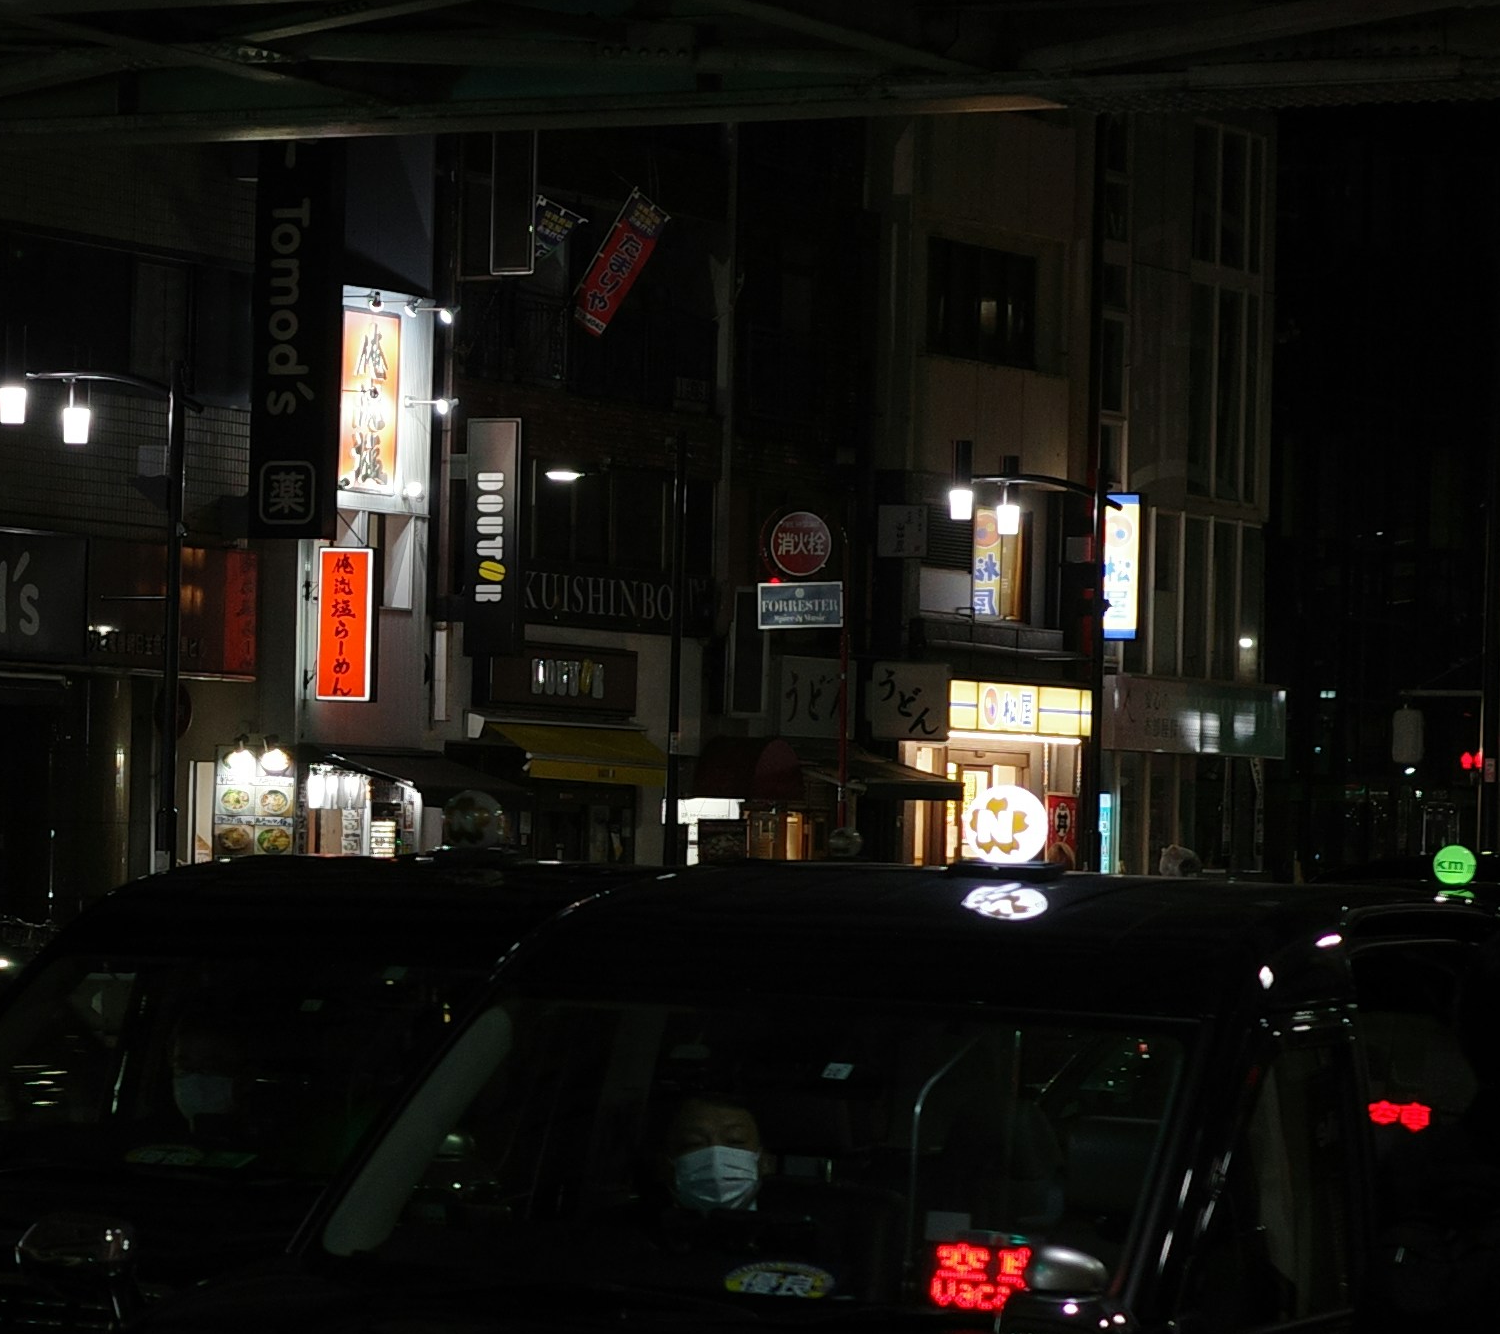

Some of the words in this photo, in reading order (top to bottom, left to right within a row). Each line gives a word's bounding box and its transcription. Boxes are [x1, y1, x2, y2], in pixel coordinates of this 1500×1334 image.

[265, 197, 315, 417] Tomod's
[270, 470, 306, 515] 薬
[475, 472, 506, 603] DOUTOR
[777, 532, 826, 556] 消火栓
[330, 554, 356, 697] 俺流塩らーめん
[762, 600, 839, 614] FORRESTER
[879, 670, 939, 735] うどん
